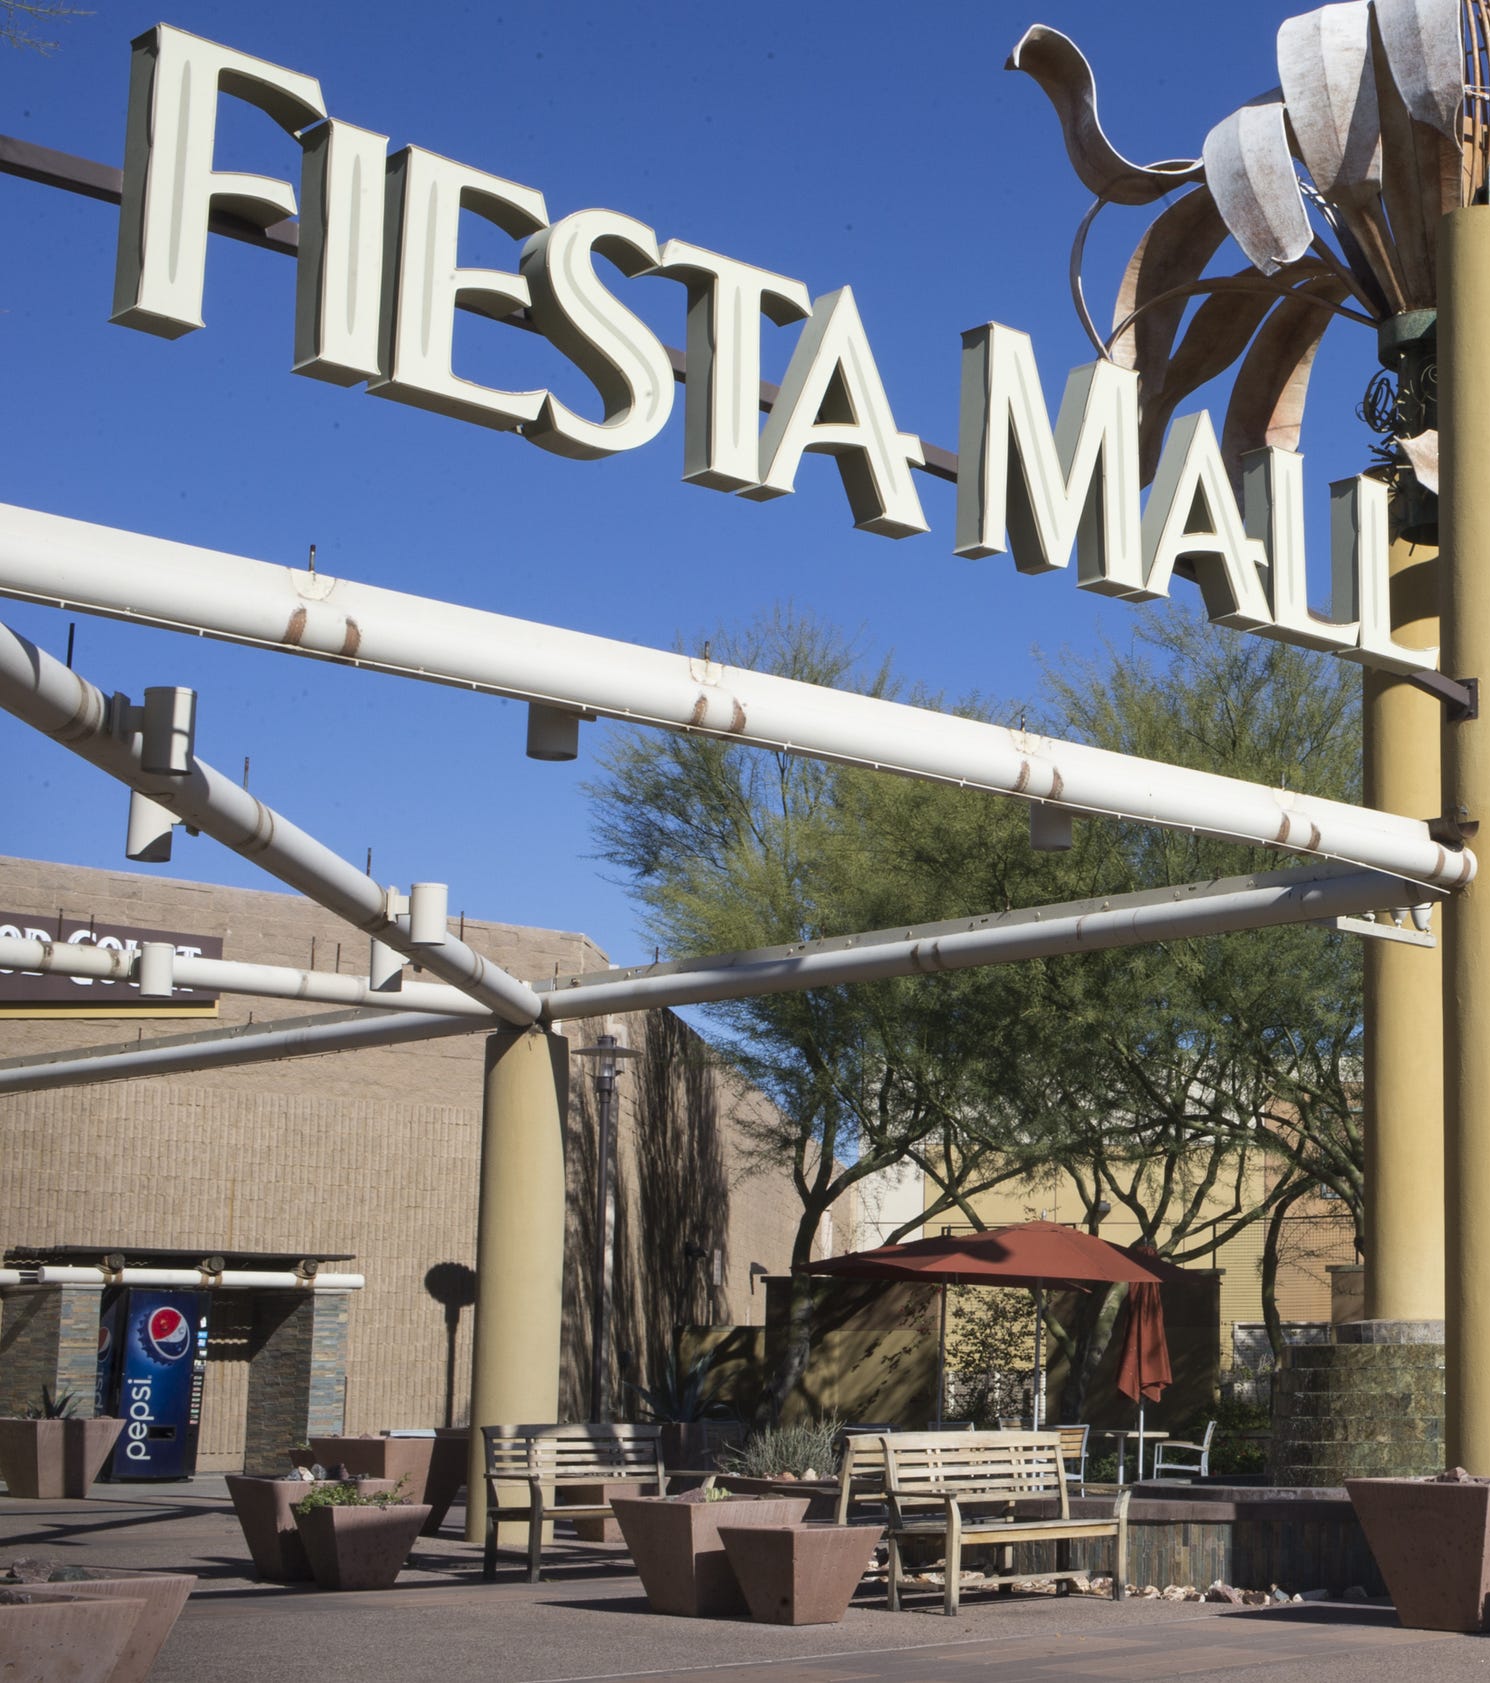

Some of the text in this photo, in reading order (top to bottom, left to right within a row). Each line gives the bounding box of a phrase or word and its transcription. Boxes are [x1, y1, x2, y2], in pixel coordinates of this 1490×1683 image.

[108, 22, 1439, 671] FIESTA MALL
[126, 1378, 154, 1461] pepsi
